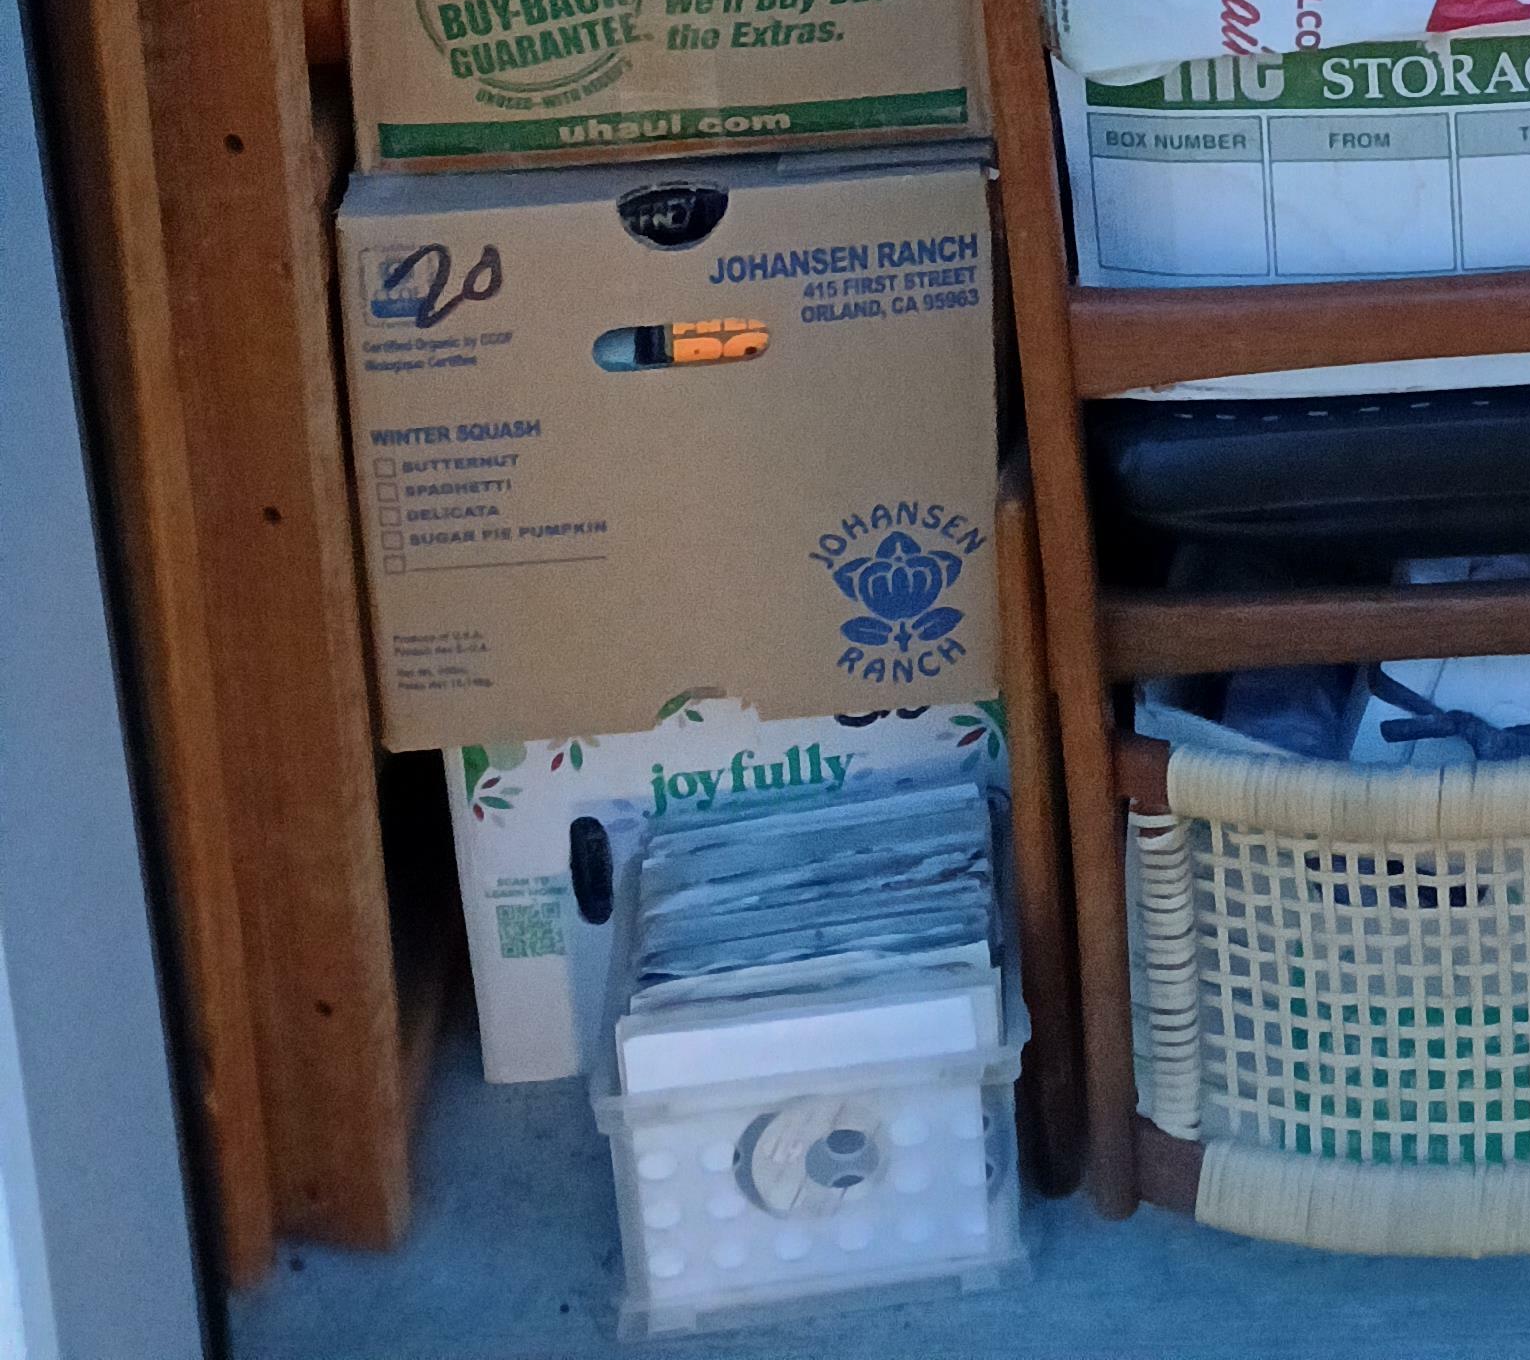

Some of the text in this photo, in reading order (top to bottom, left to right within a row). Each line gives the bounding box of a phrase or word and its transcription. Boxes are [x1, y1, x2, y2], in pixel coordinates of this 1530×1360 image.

[666, 16, 845, 53] the Extras.
[558, 109, 793, 146] uhaul.com
[1104, 128, 1150, 151] BOX
[1154, 132, 1248, 152] NUMBER
[1328, 131, 1392, 151] FROM
[708, 232, 980, 285] JOHANSEN RANCH
[843, 274, 898, 296] FIRST
[903, 265, 978, 291] STREET
[801, 298, 887, 324] ORLAND,
[891, 295, 918, 314] CA
[370, 418, 542, 448] WINTER SQUASH
[401, 453, 520, 475] BUTTERNUT
[405, 478, 513, 499] SPAGHETTI
[406, 505, 500, 523] DELICATA
[409, 528, 476, 548] SUGAR
[518, 519, 608, 540] PUMPKIN
[808, 499, 988, 571] JOHANSEN
[835, 636, 967, 685] RANCH
[646, 741, 858, 817] joyfully
